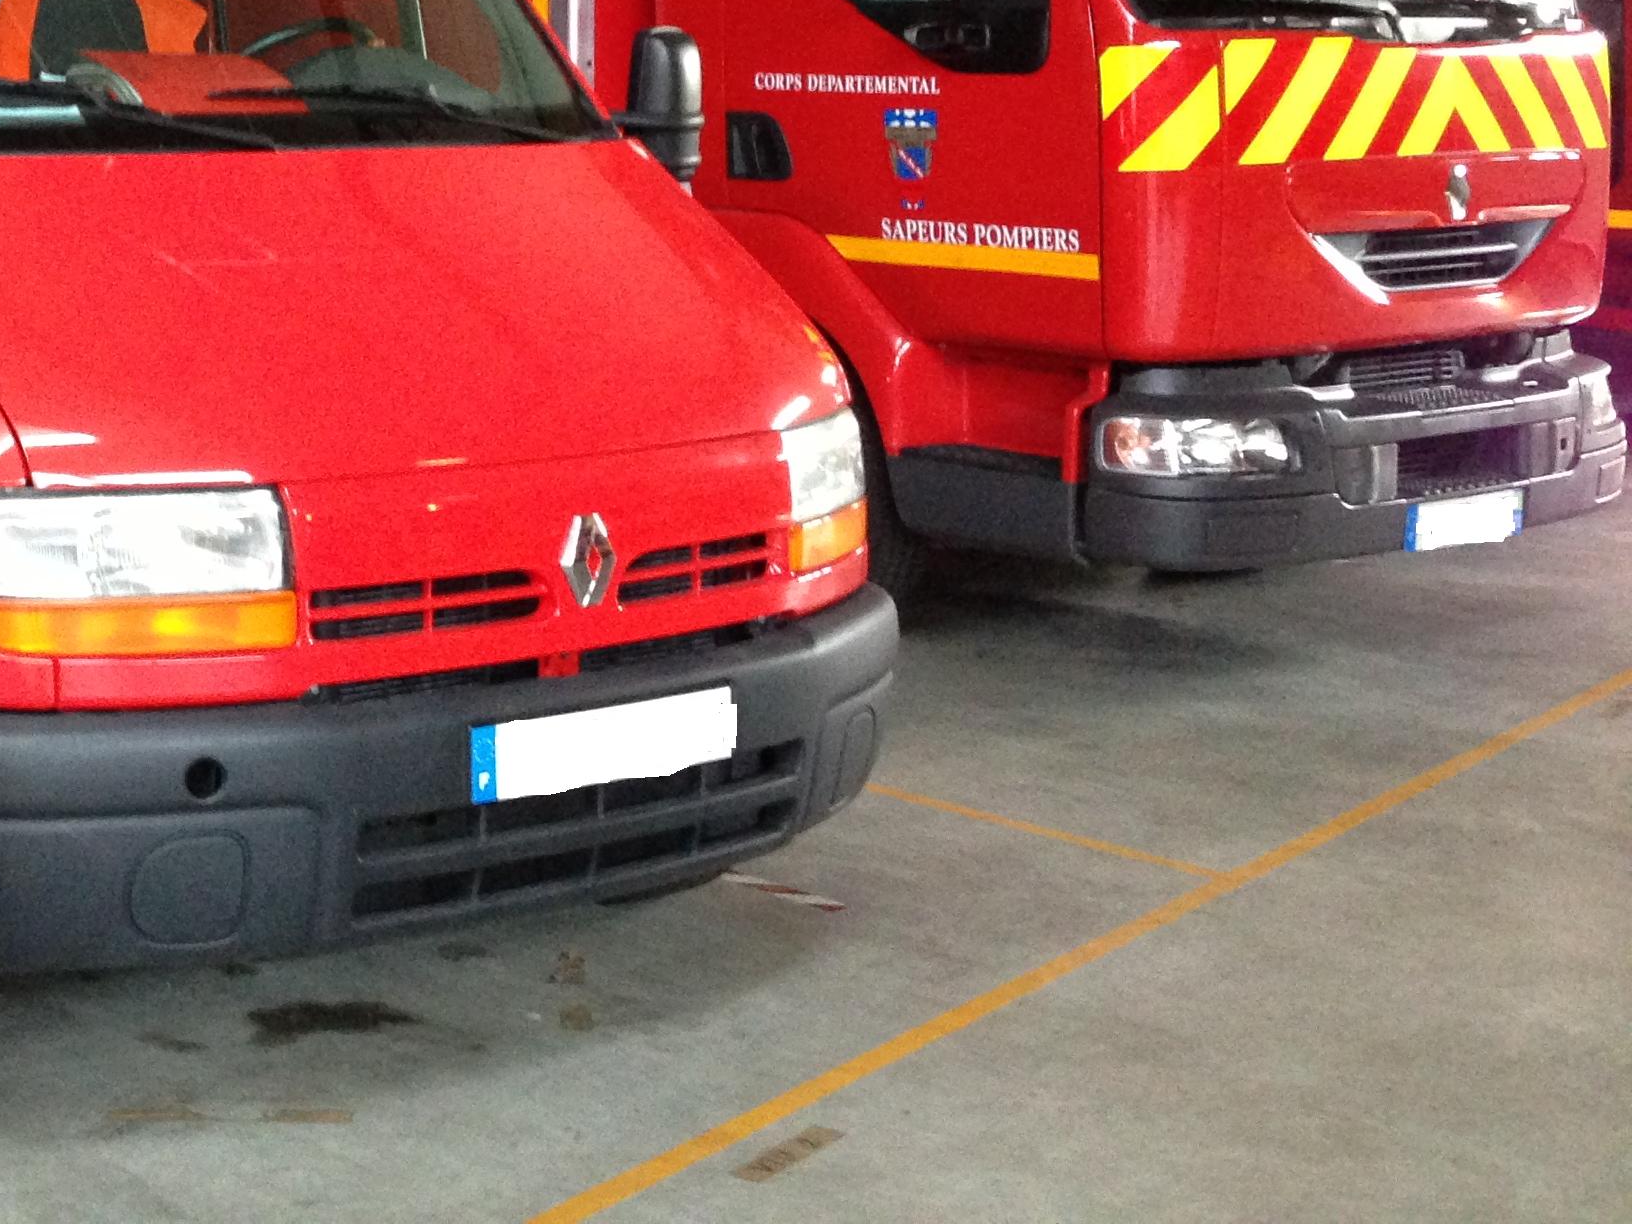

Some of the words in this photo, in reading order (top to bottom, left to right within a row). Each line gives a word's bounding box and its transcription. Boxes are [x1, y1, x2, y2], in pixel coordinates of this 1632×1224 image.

[754, 72, 802, 91] CORPS
[807, 73, 940, 95] DEPARTEMENTAL
[881, 217, 968, 245] SAPEURS
[972, 223, 1080, 253] POMPIERS
